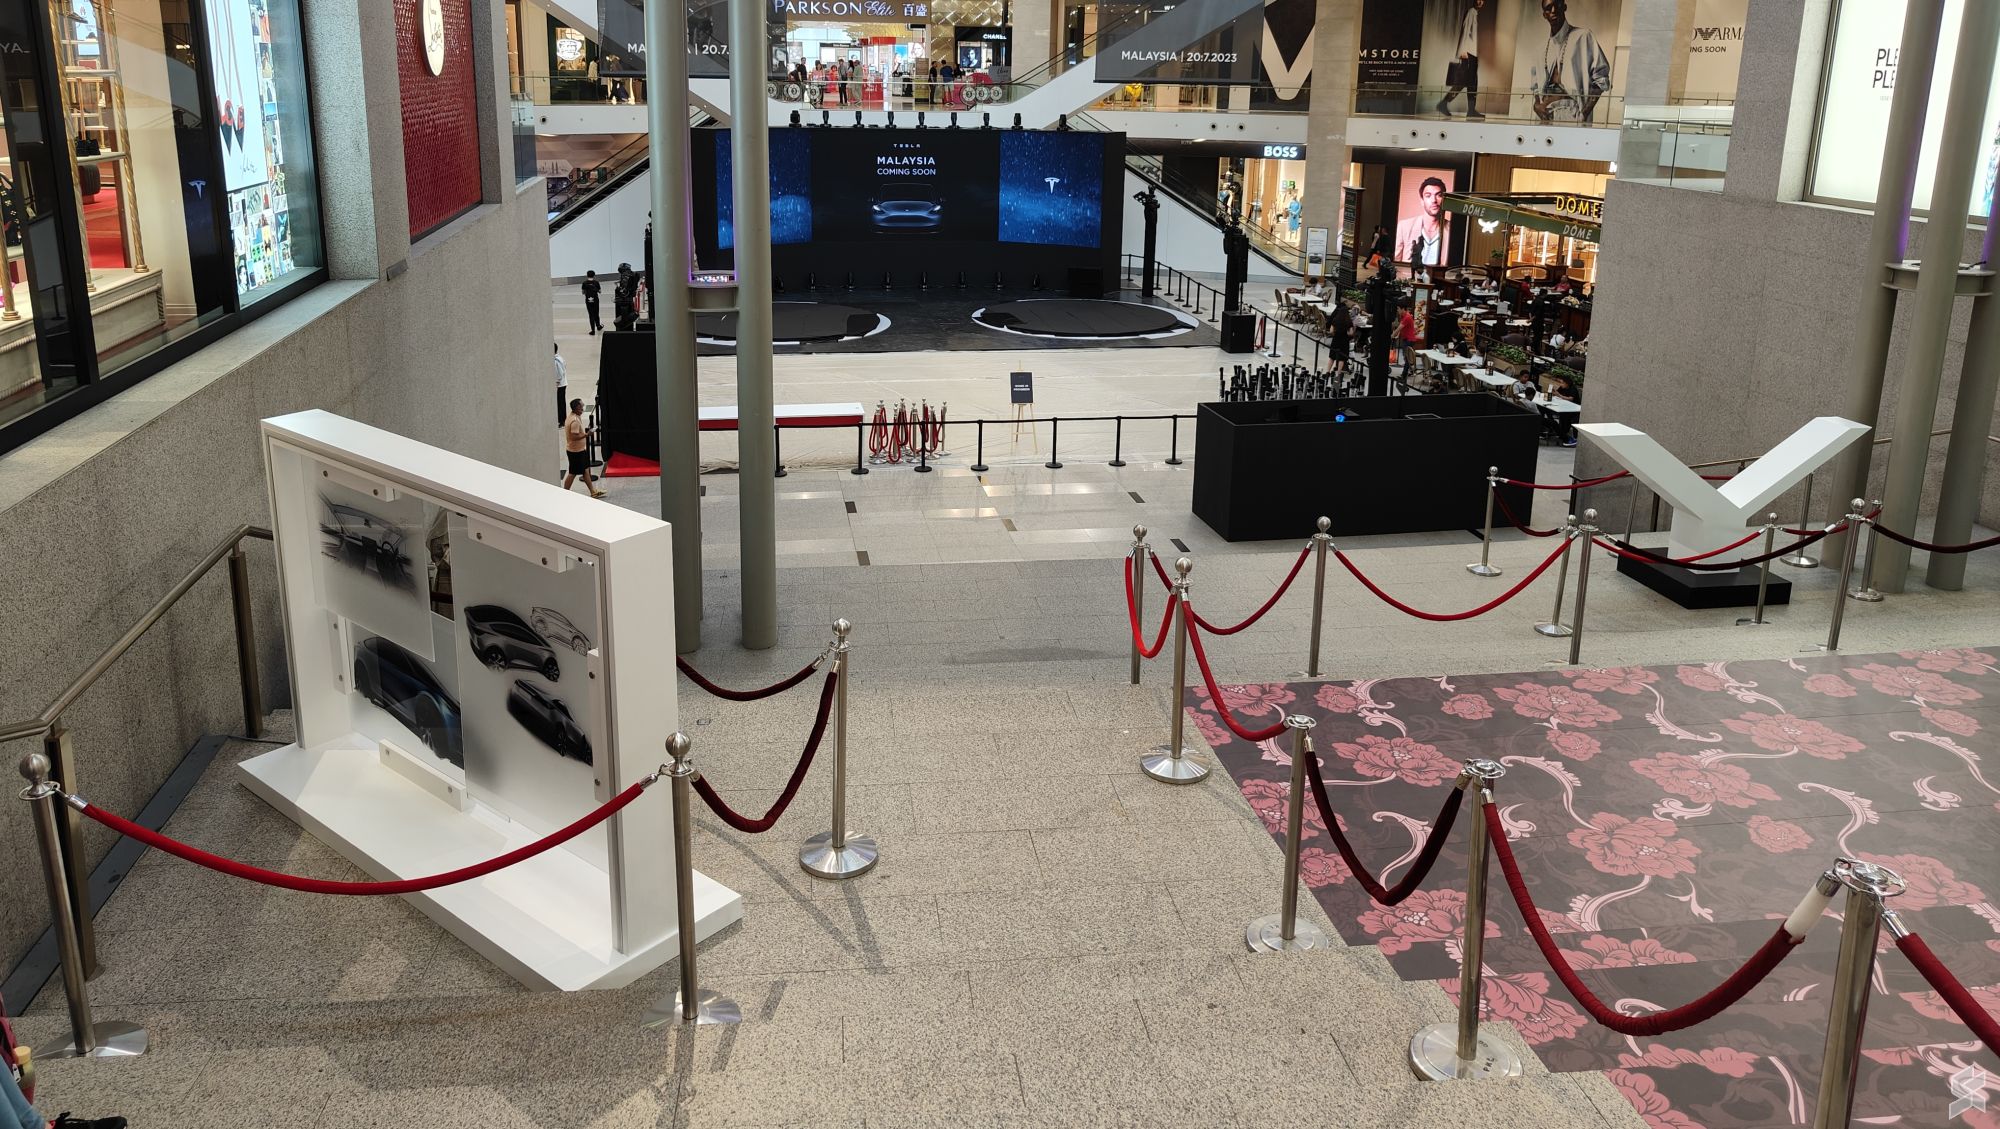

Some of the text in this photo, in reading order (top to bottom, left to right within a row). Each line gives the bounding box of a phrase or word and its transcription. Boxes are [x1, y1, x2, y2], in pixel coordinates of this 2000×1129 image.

[774, 0, 896, 16] PARKSON Elite
[902, 3, 928, 17] 百盛
[702, 44, 730, 55] 20.7.
[1121, 51, 1178, 61] MALAYSIA
[1876, 48, 1899, 67] PLE
[1872, 70, 1896, 89] PLE
[1263, 145, 1298, 158] BOSS
[877, 156, 936, 165] MALAYSIA
[877, 168, 937, 176] COMING SOON
